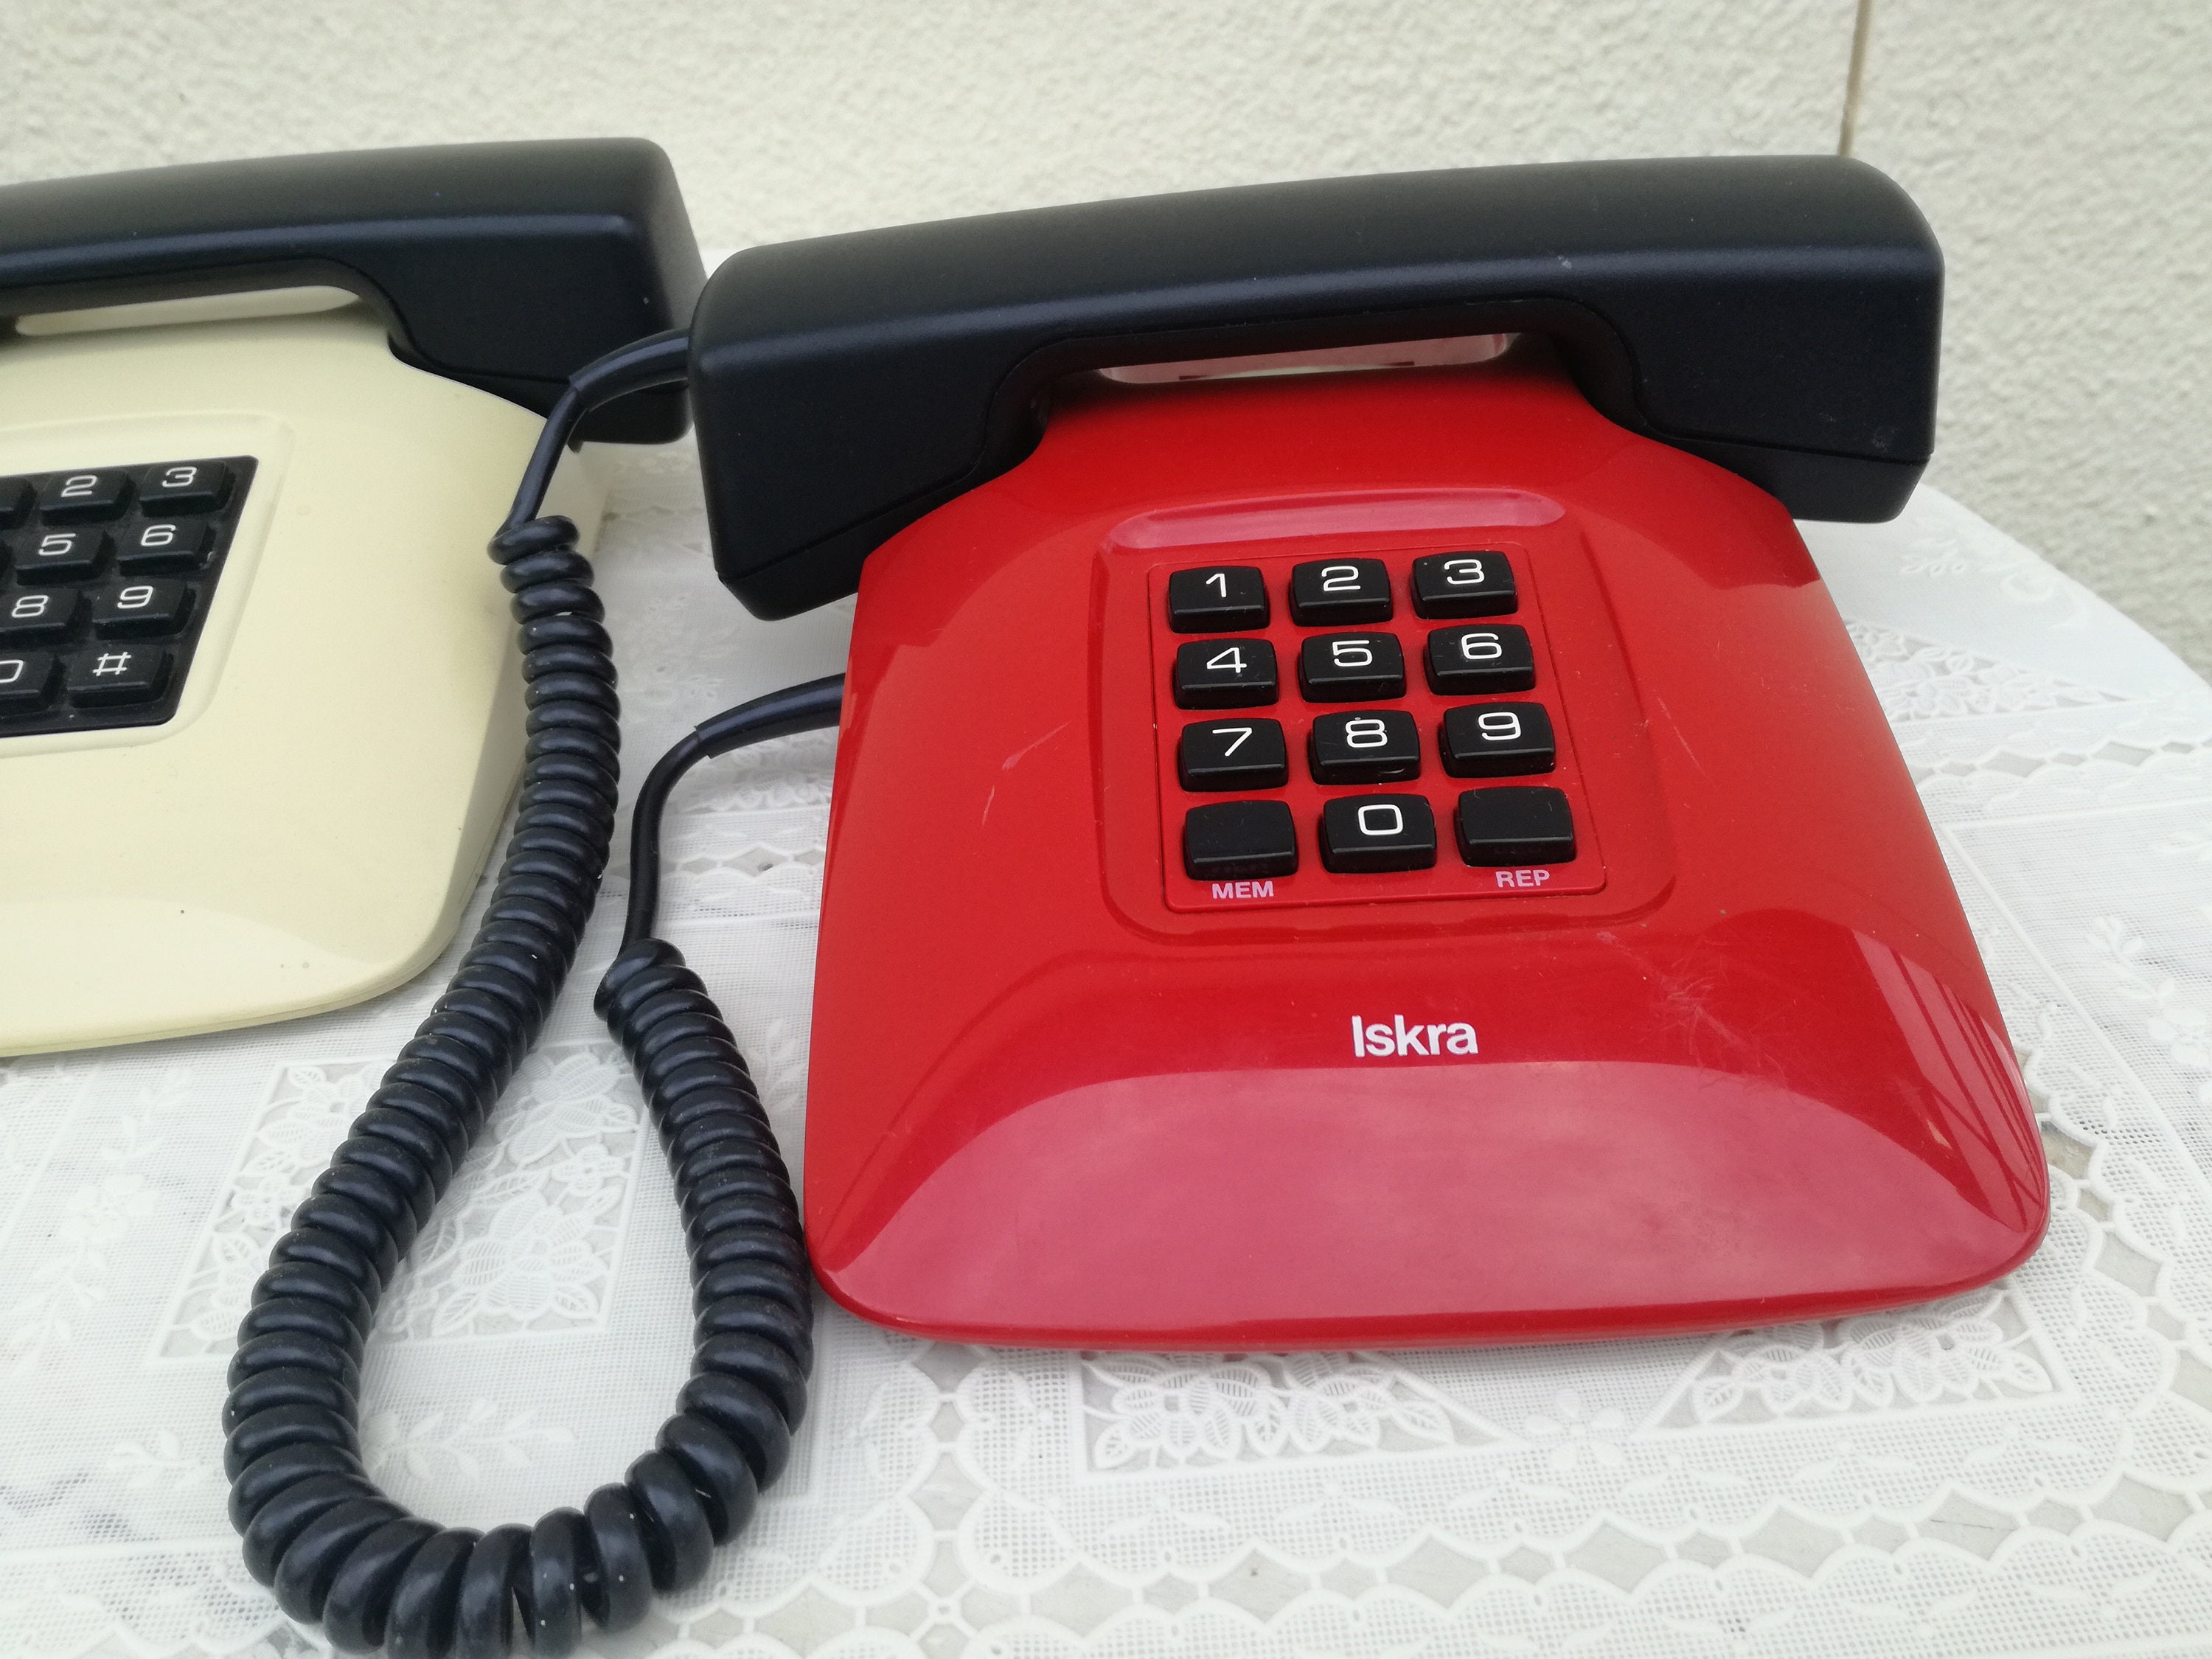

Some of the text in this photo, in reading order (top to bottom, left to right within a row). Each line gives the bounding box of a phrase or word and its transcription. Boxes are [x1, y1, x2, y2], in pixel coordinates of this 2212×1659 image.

[60, 474, 98, 498] 2
[161, 466, 198, 488] 3
[38, 532, 77, 556] 5
[140, 524, 177, 547] 6
[1321, 566, 1361, 592] 2
[1444, 558, 1485, 585] 3
[116, 585, 154, 609] 9
[1206, 573, 1227, 598] 1
[10, 594, 49, 619] 8
[1332, 639, 1373, 667] 5
[1461, 633, 1503, 660] 6
[1206, 647, 1248, 674] 4
[1345, 719, 1388, 748] 8
[1478, 712, 1522, 741] 9
[1211, 727, 1253, 757] 7
[1357, 804, 1404, 836] 0
[1211, 880, 1274, 900] MEM
[1495, 869, 1551, 888] REP
[1352, 1014, 1478, 1057] Iskra
